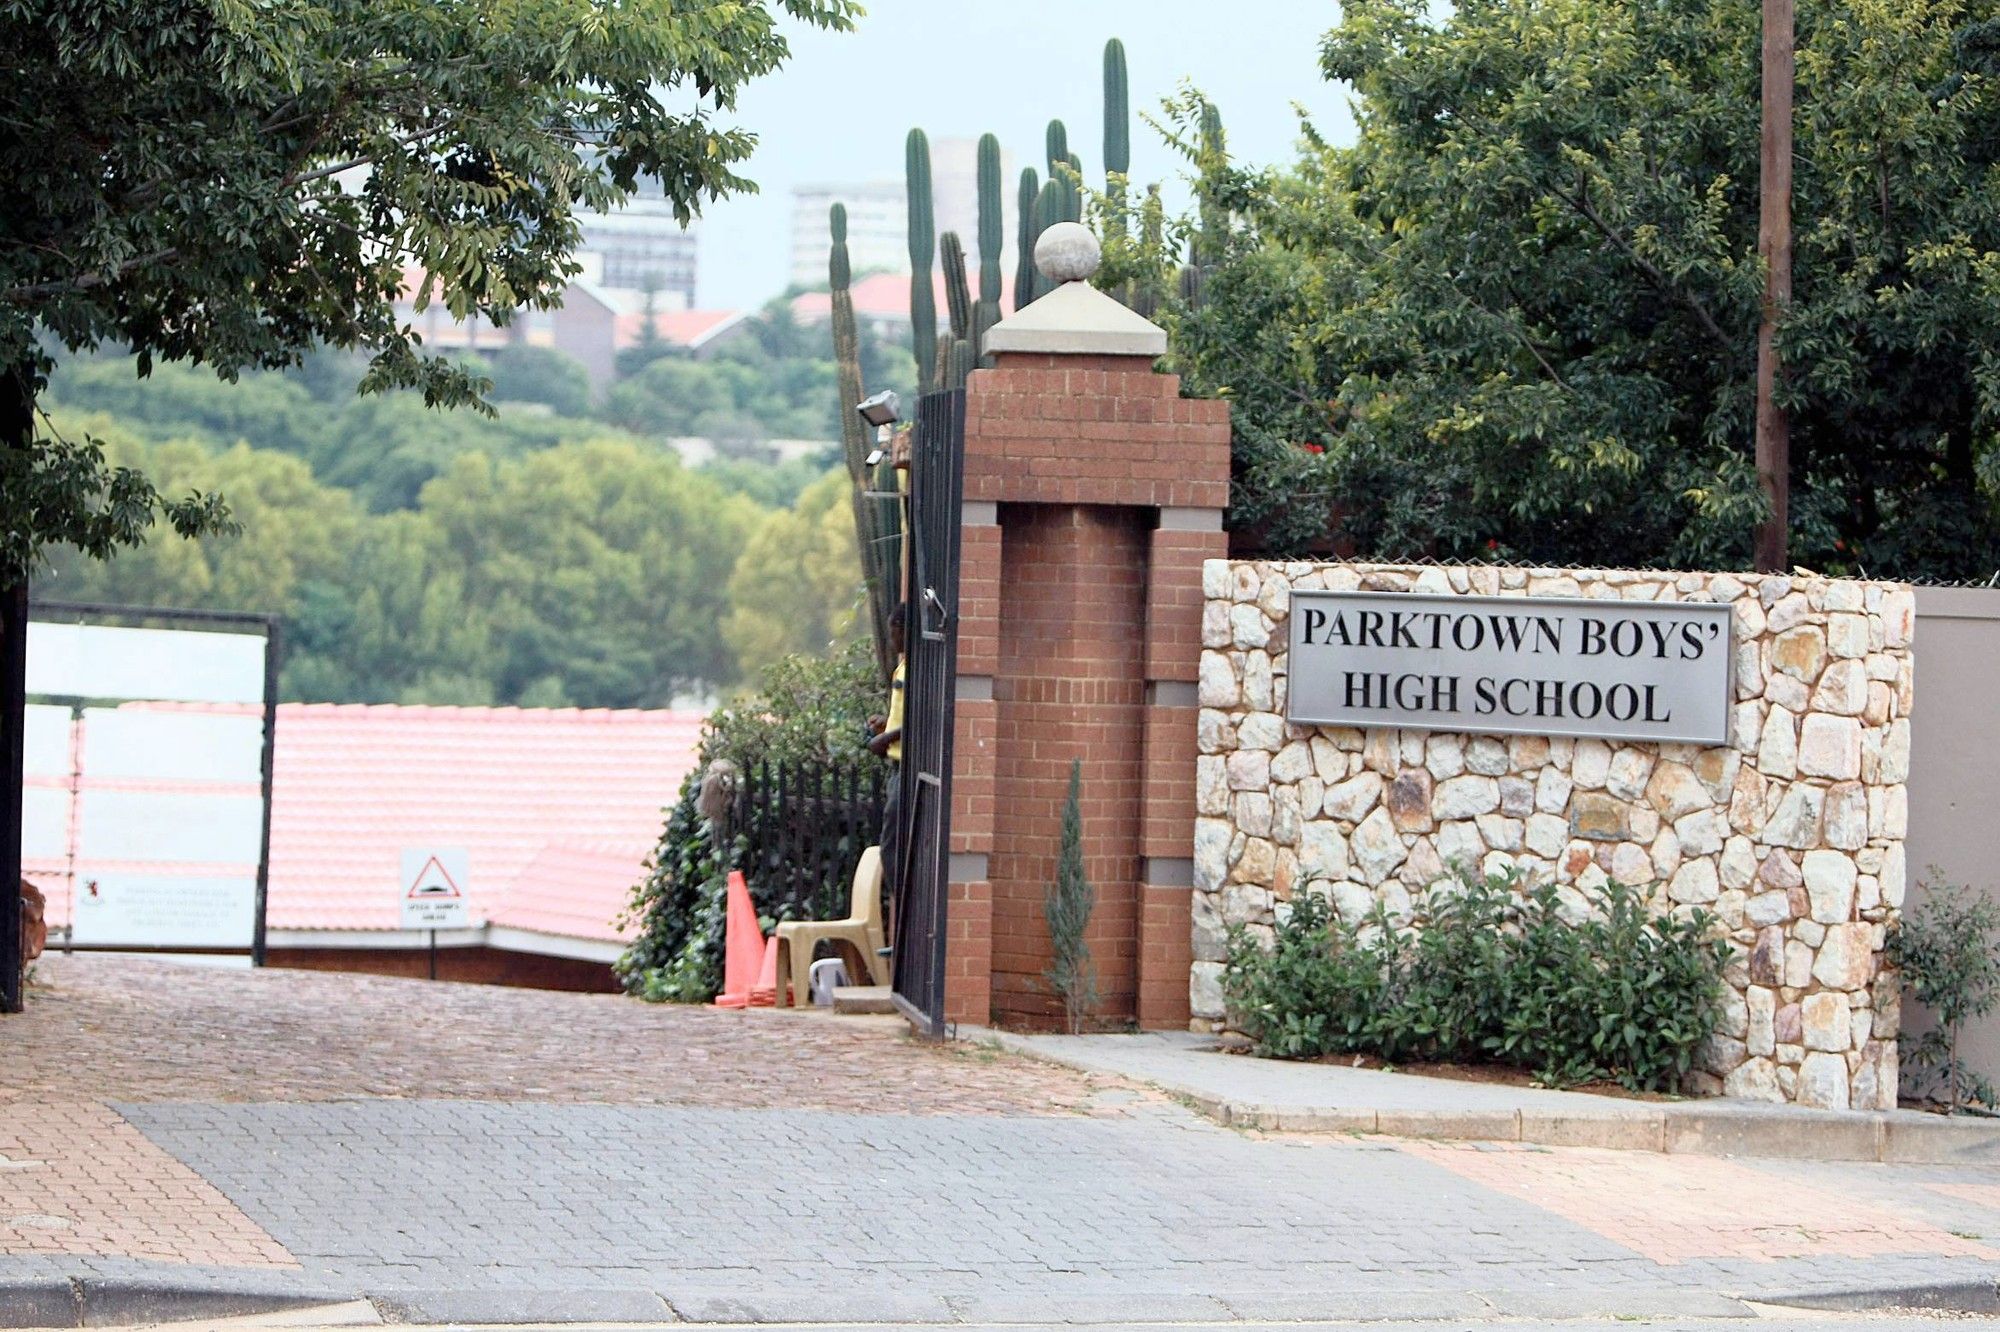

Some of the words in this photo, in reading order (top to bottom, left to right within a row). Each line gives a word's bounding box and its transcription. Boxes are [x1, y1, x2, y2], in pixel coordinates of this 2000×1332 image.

[1301, 608, 1564, 654] PARKTOWN
[1579, 617, 1719, 660] BOYS'
[1341, 671, 1460, 713] HIGH
[1474, 676, 1671, 723] SCHOOL
